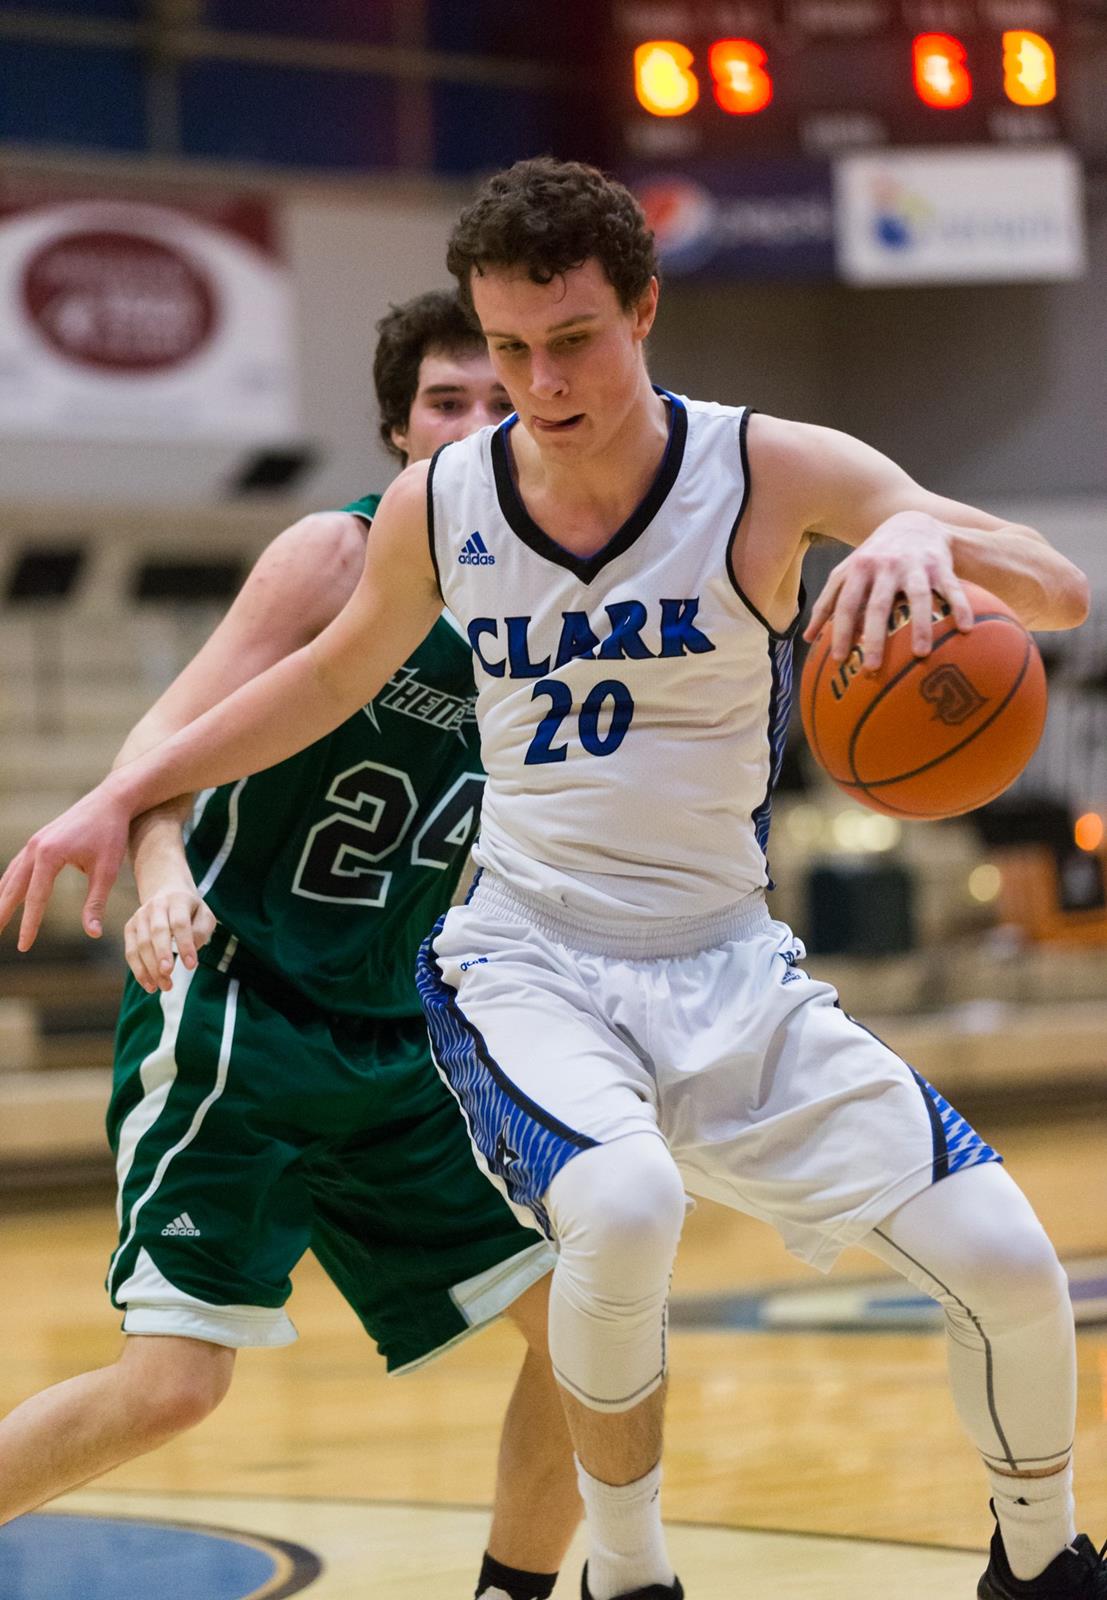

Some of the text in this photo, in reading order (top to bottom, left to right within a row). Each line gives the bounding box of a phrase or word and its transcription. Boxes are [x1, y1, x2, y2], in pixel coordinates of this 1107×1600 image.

[467, 597, 716, 679] CLARK
[524, 679, 634, 765] 20
[291, 760, 487, 908] 24
